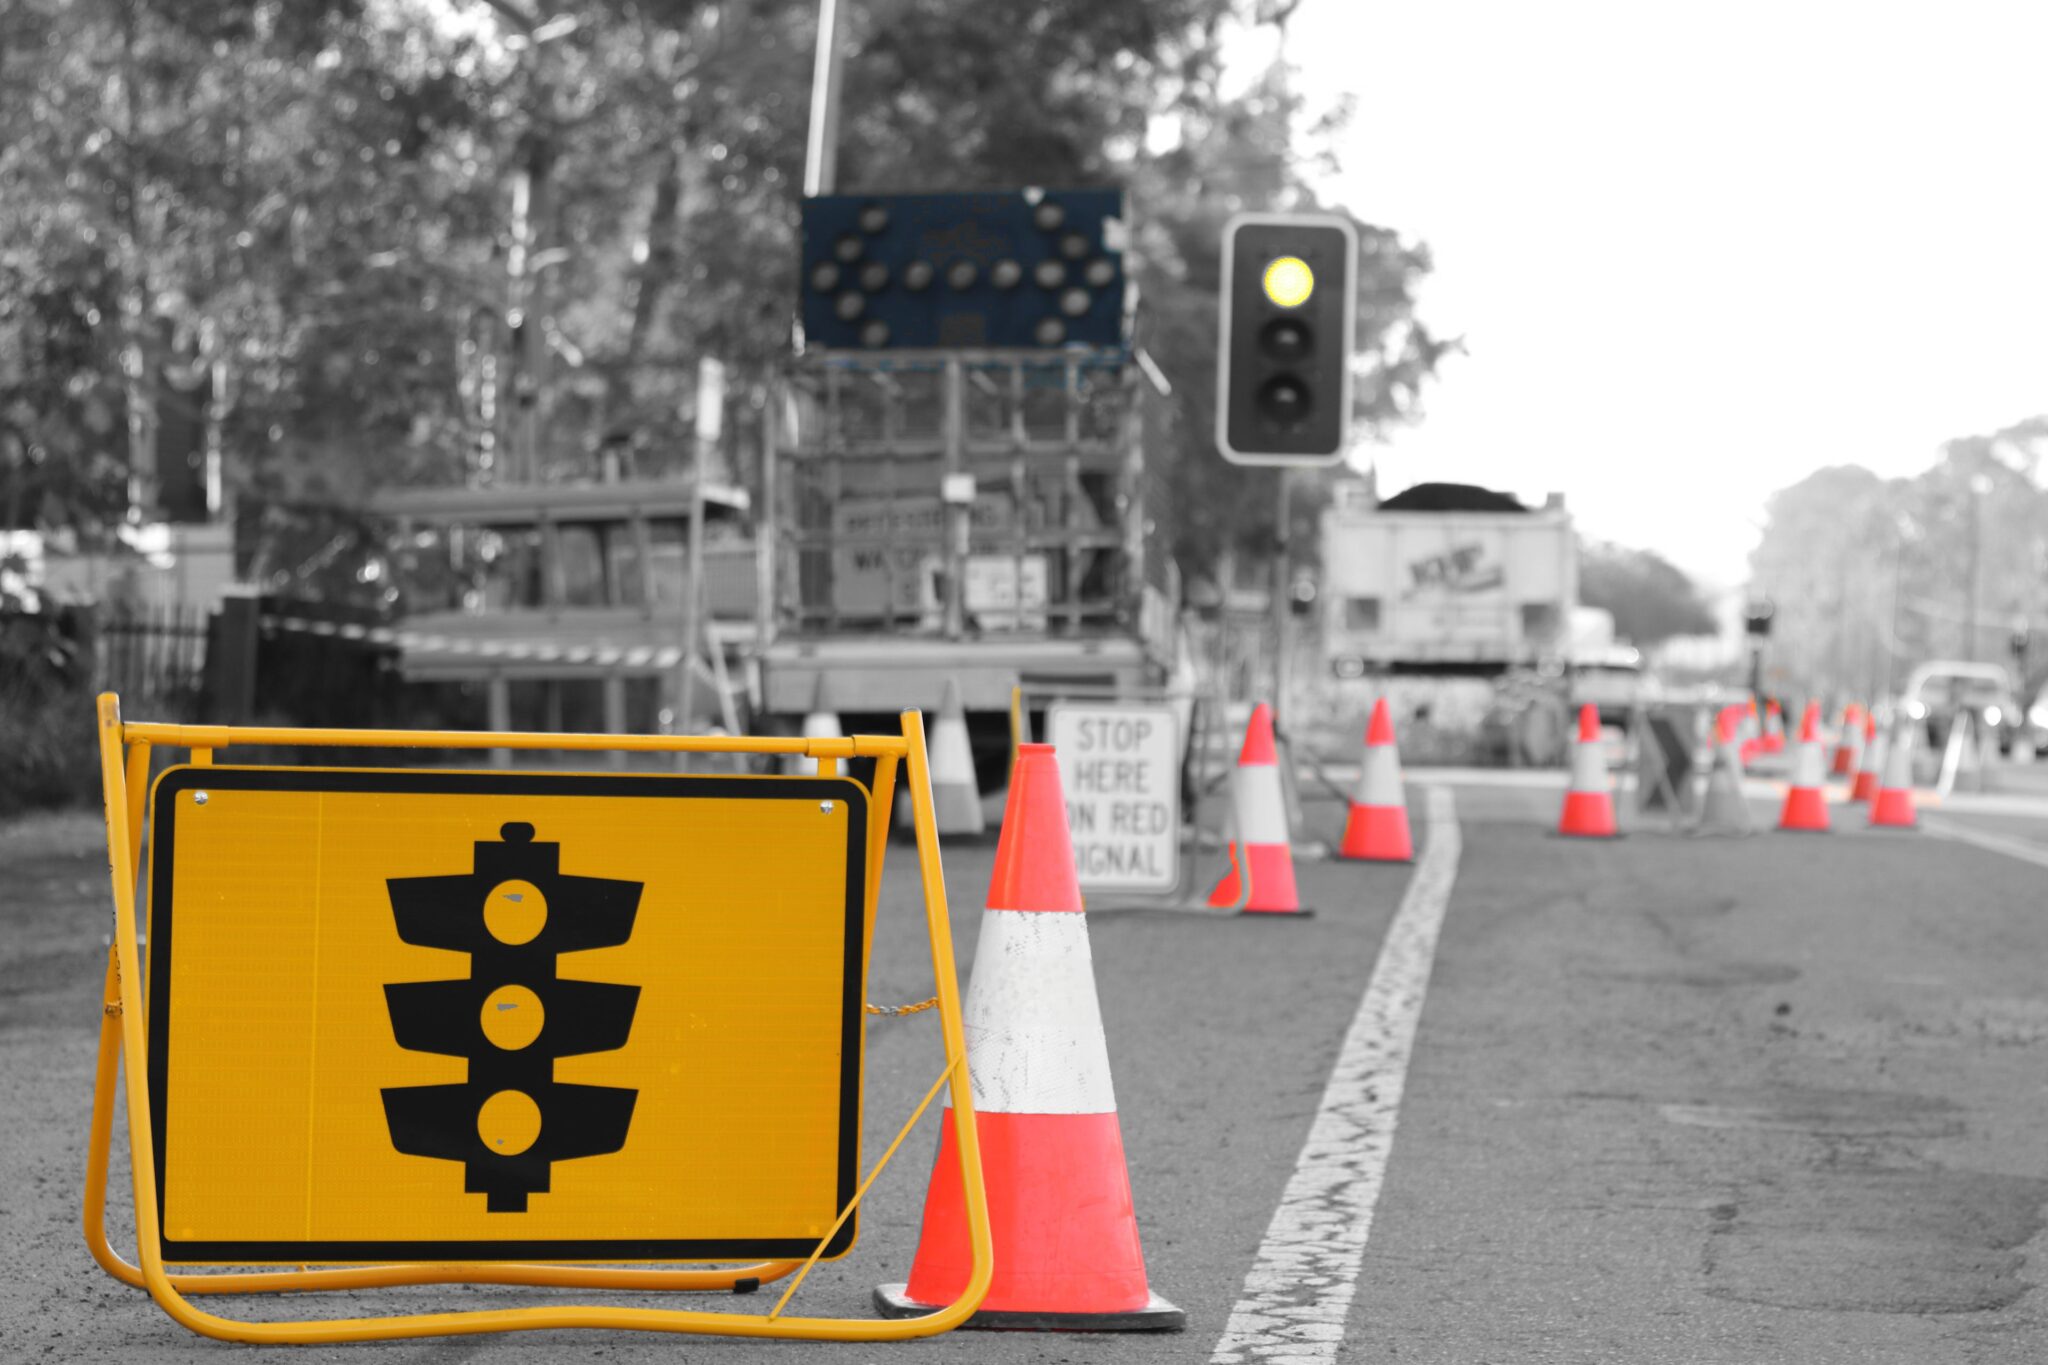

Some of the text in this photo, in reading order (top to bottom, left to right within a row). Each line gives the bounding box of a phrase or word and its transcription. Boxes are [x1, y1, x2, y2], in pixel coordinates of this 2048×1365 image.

[1078, 718, 1152, 751] STOP
[1075, 760, 1151, 794] HERE
[1111, 802, 1170, 836] RED
[1073, 842, 1163, 877] IGNAL
